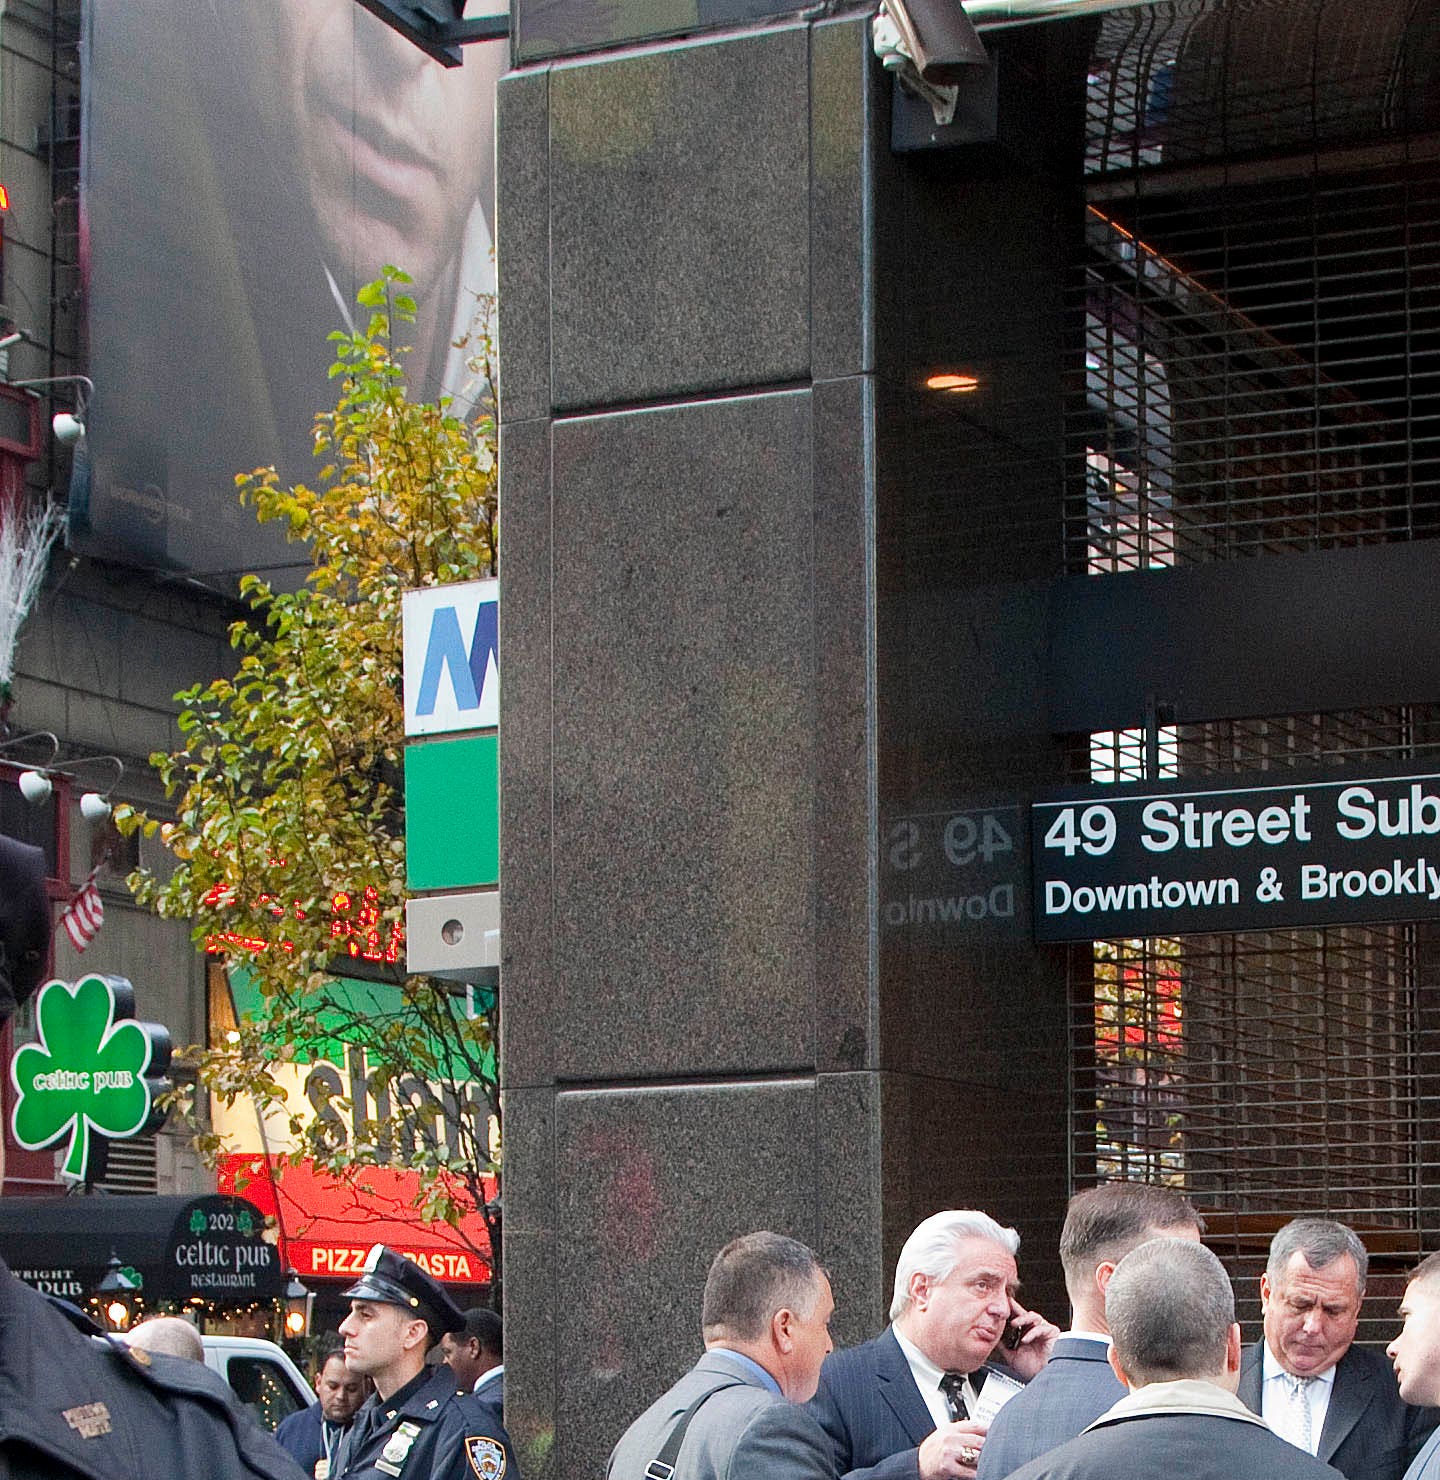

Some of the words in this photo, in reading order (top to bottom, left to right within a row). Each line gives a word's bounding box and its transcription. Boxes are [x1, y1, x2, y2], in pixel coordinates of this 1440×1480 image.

[1043, 804, 1118, 858] 49
[1140, 795, 1314, 853] Street
[1044, 875, 1240, 916] Downtown
[1254, 867, 1285, 903] &
[209, 1214, 234, 1230] 202
